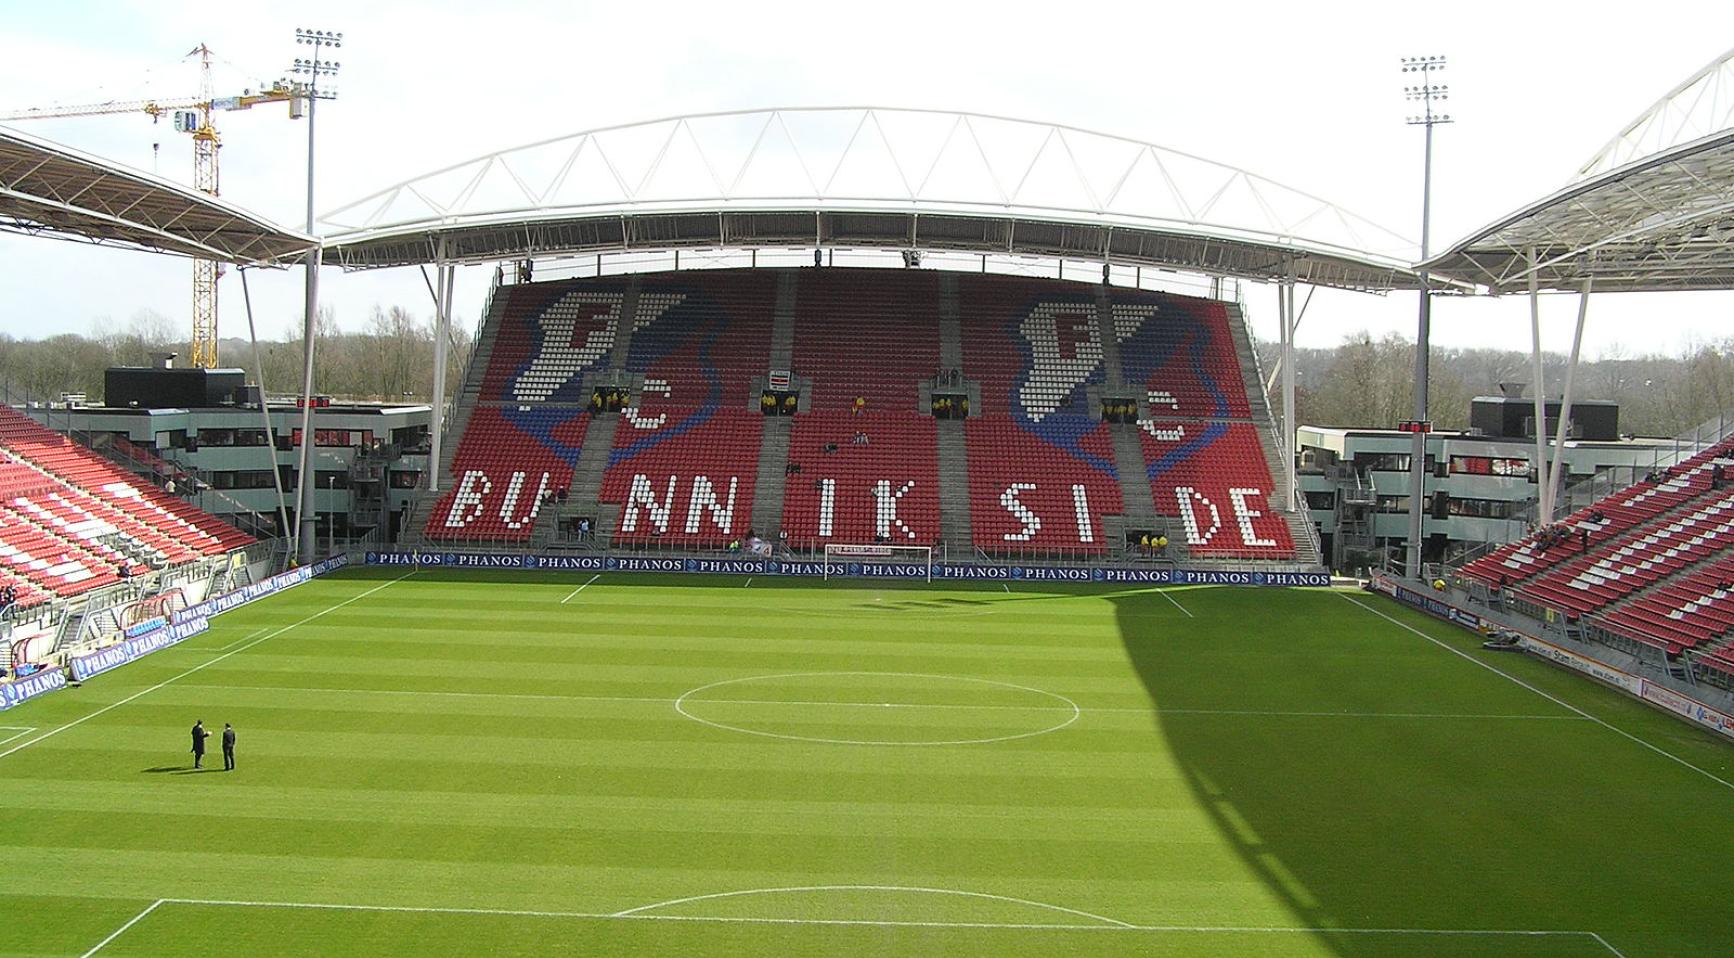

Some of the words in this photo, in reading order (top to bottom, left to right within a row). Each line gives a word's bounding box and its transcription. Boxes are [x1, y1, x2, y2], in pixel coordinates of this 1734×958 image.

[380, 553, 442, 565] PHANOS
[458, 555, 520, 566] PHANOS
[539, 557, 601, 568] PHANOS
[619, 559, 682, 570] PHANOS
[701, 561, 763, 573] PHANOS
[781, 564, 844, 575] PHANOS
[862, 565, 926, 576] PHANOS
[944, 567, 1007, 578] PHANOS
[1025, 568, 1088, 580] PHANOS
[1106, 571, 1169, 581] PHANOS
[1187, 573, 1249, 583] PHANOS
[1266, 574, 1328, 585] PHANOS
[218, 592, 244, 612] PHANOS
[176, 617, 209, 640] PHANOS
[133, 629, 170, 656] PHANOS
[86, 646, 126, 674] PHANOS
[15, 669, 66, 700] PHANOS
